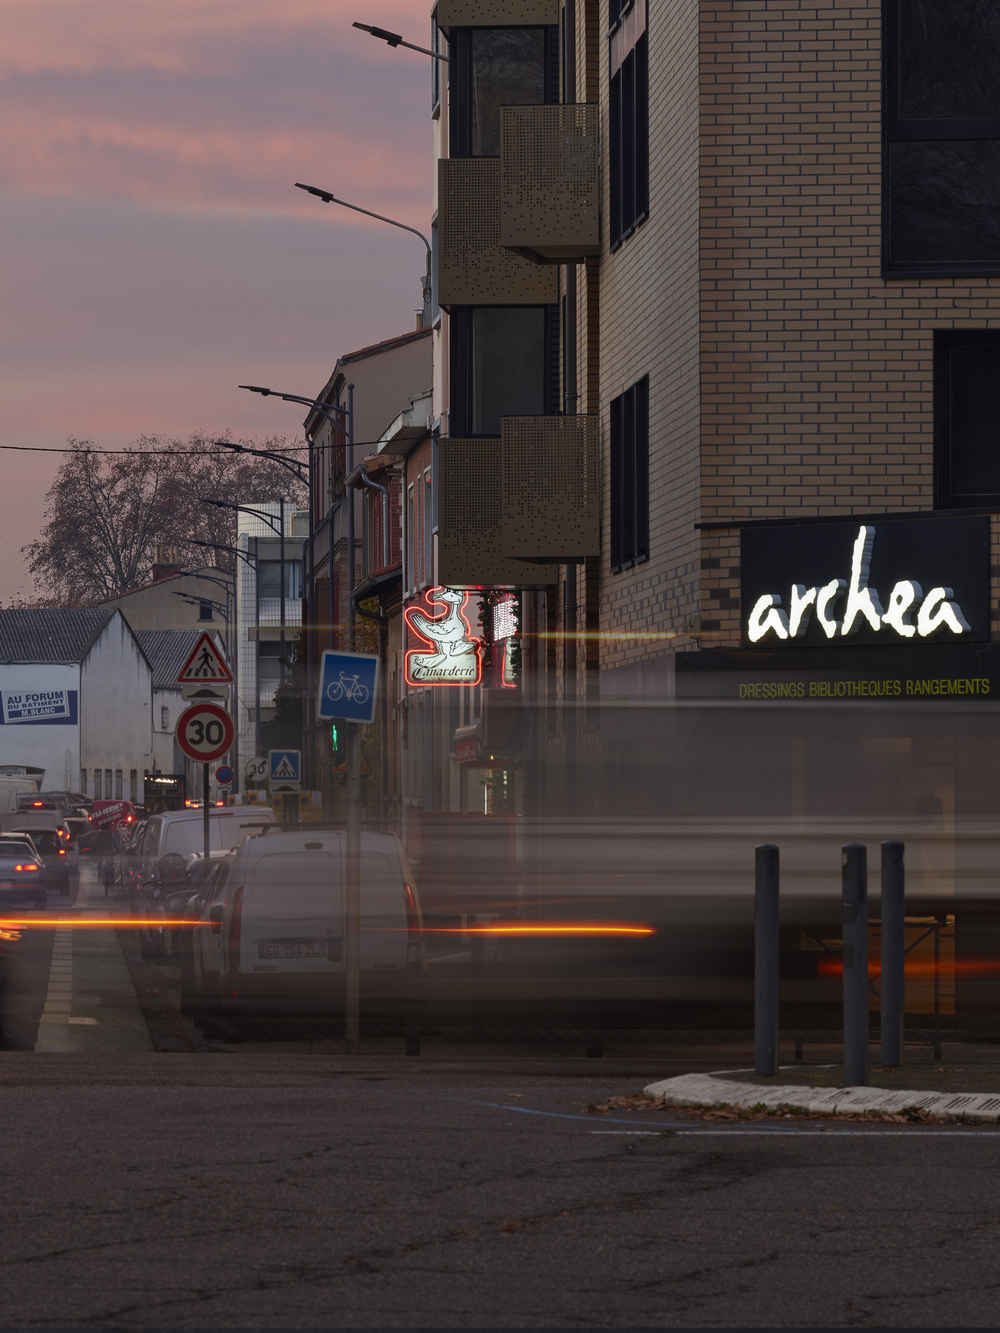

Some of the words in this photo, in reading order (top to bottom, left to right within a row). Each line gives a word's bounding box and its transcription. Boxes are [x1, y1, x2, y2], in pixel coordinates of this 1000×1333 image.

[747, 525, 969, 643] archea
[739, 682, 805, 698] DRESSINGS
[809, 680, 902, 697] BIBLIOTHEQUES
[905, 678, 990, 695] RANGEMENTS
[7, 696, 22, 705] AU
[25, 691, 64, 702] FORUM
[21, 699, 64, 709] BATIMENT
[188, 720, 223, 745] 30
[250, 764, 265, 775] 30
